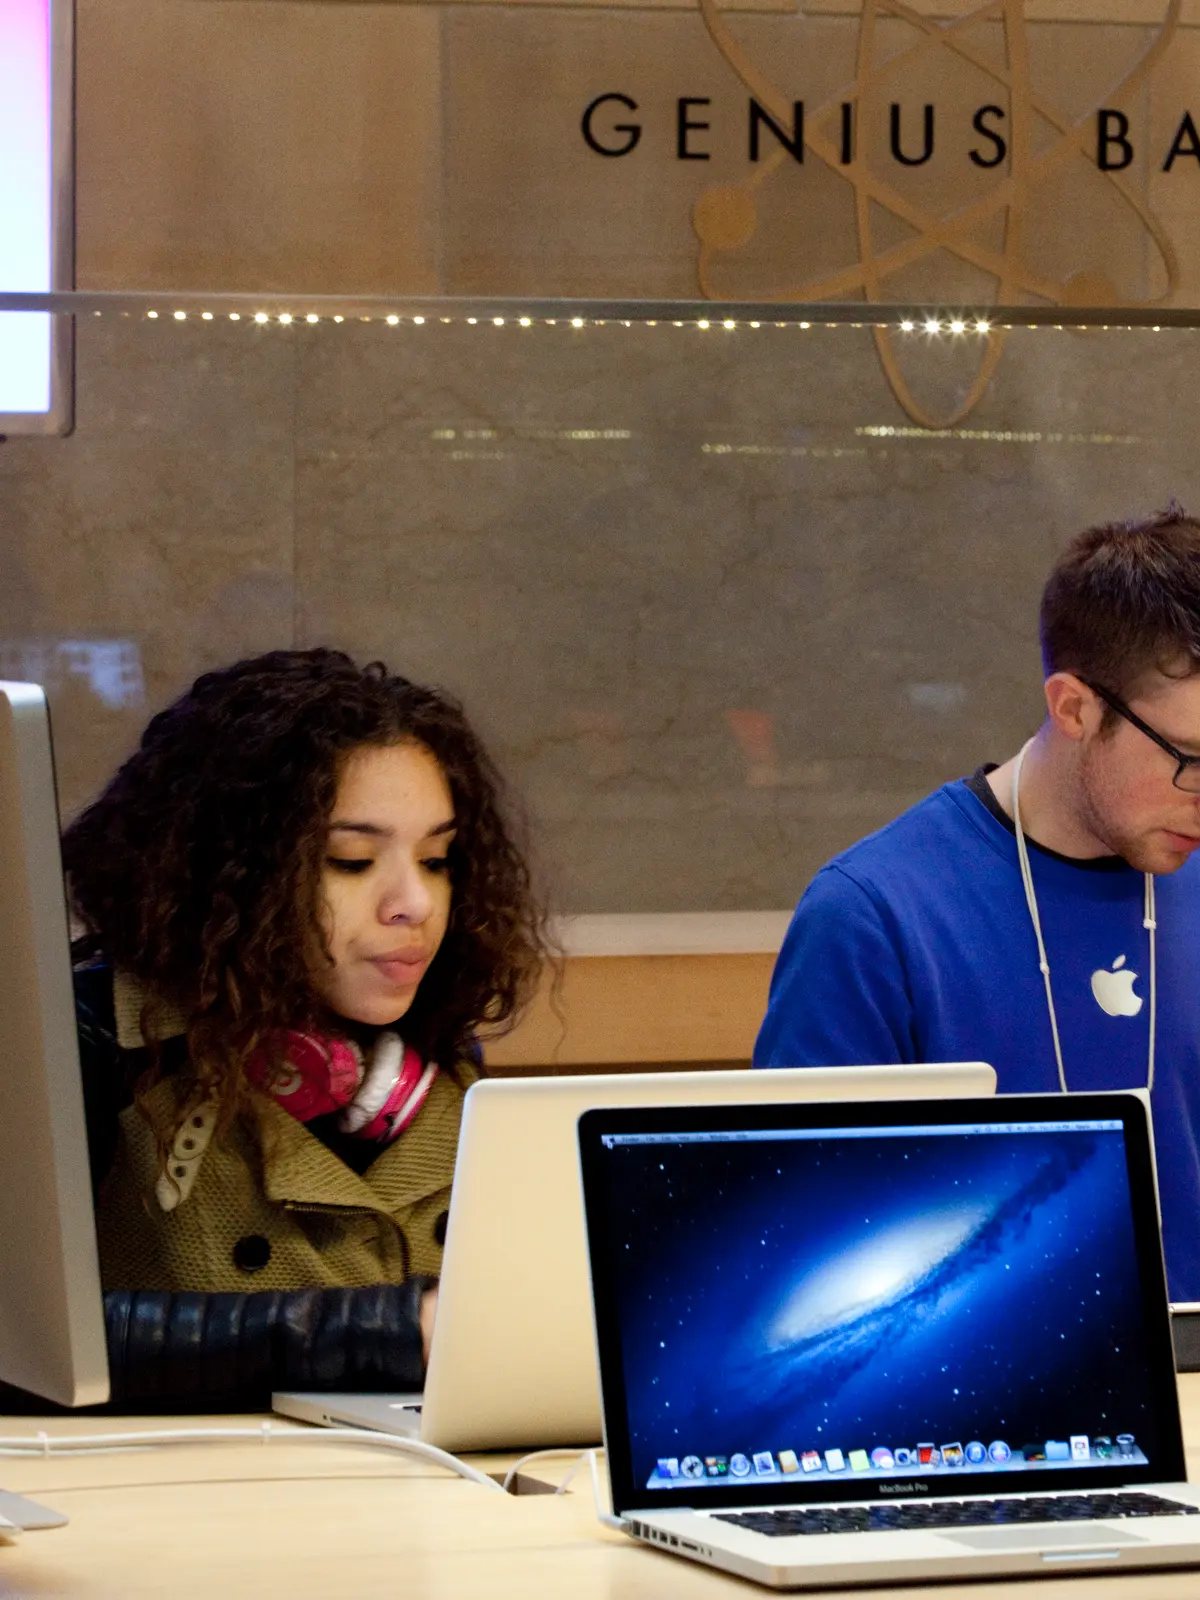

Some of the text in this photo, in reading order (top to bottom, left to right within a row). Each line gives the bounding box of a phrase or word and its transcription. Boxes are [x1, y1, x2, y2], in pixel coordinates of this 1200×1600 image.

[581, 93, 1006, 168] GENIUS
[879, 1482, 929, 1493] MacBook Pro
